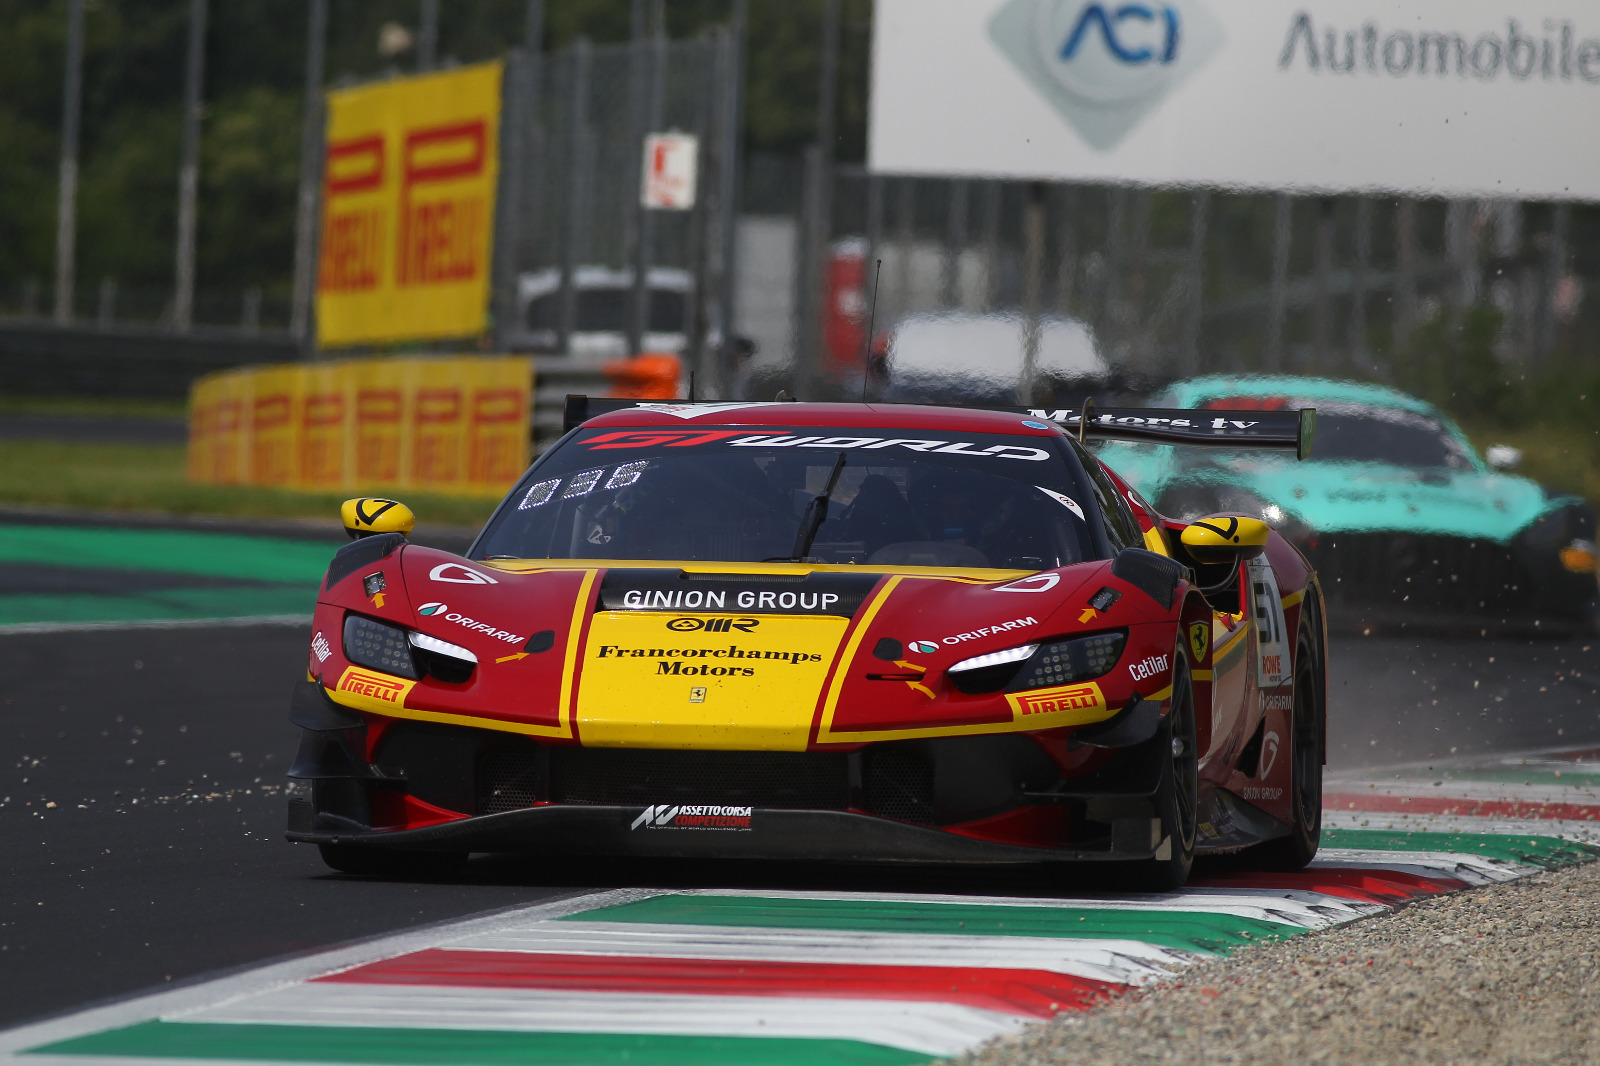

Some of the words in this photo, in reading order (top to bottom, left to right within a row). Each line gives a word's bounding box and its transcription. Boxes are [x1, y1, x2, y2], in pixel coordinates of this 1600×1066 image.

[1060, 4, 1180, 64] ACI
[1277, 10, 1600, 83] Automobile
[623, 590, 726, 609] GINION
[737, 591, 839, 610] GROUP
[444, 613, 525, 645] ORIFARM
[942, 616, 1039, 645] ORIFARM
[311, 631, 333, 663] Cetilar
[596, 645, 823, 665] Francorchamps
[655, 661, 755, 677] Motors
[1128, 654, 1169, 681] Cetilar
[341, 671, 405, 703] PIRELLI
[1015, 687, 1098, 715] PIRELLI
[674, 815, 752, 827] COMPETIZIONE
[678, 805, 721, 816] ASSETTO
[721, 806, 752, 817] CORSA
